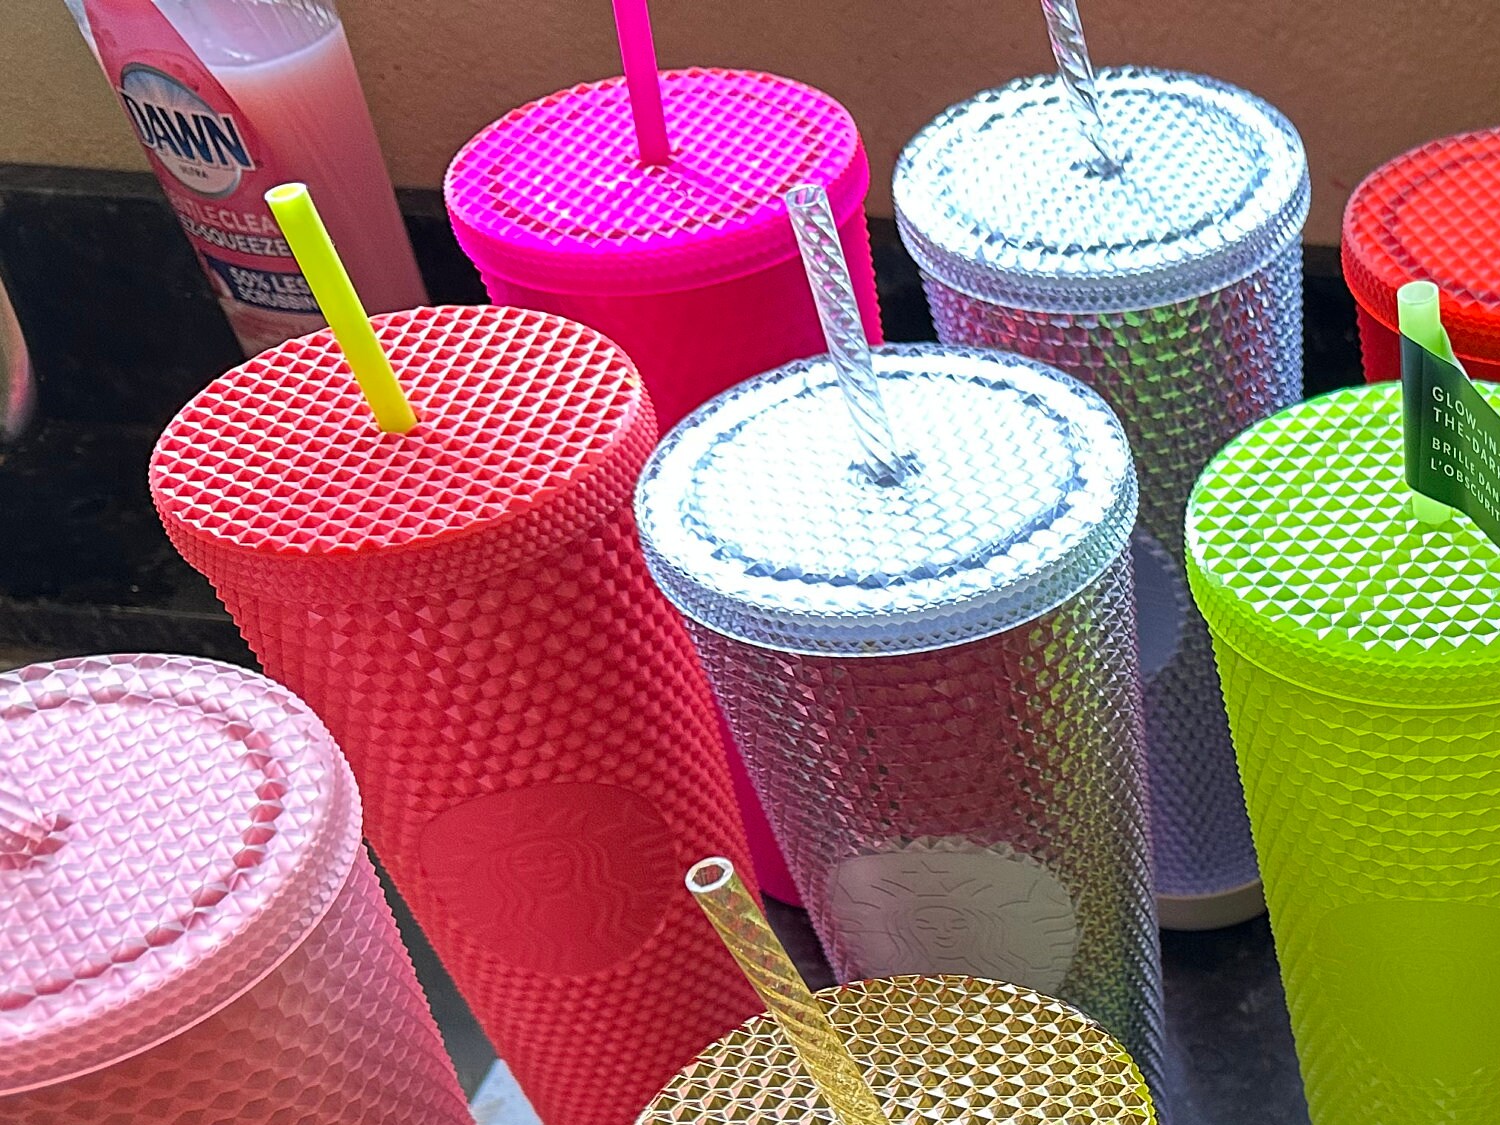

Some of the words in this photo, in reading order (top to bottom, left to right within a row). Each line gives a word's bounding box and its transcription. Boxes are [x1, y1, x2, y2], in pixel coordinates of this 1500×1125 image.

[120, 91, 253, 168] DAWN
[219, 208, 278, 235] CLEA
[270, 273, 310, 295] LES
[1432, 437, 1476, 476] BRILLE
